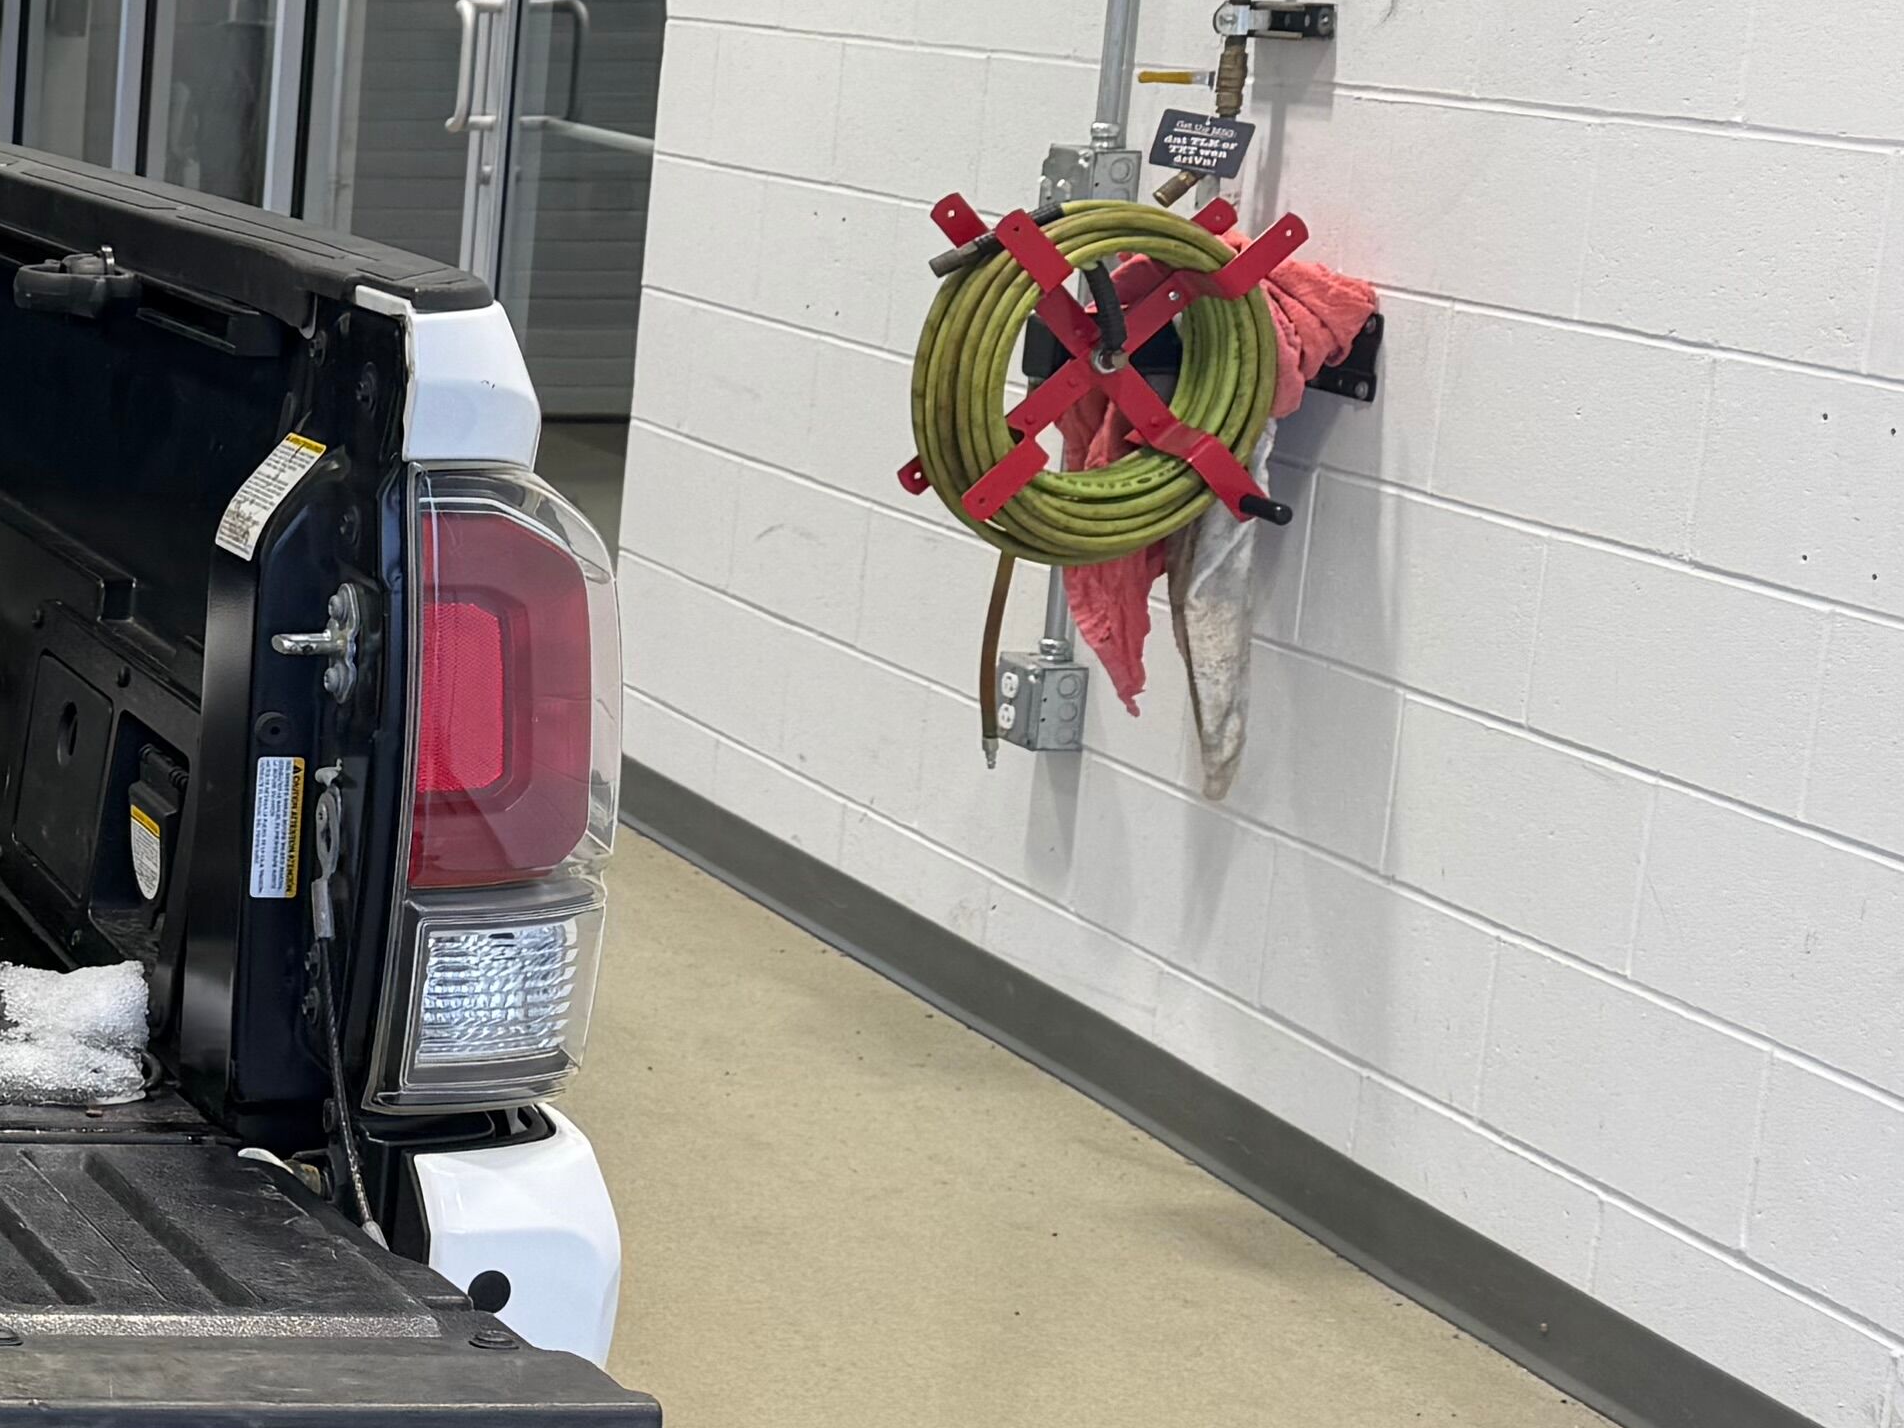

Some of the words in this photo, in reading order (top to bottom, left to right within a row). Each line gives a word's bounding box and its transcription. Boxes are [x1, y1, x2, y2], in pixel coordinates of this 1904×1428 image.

[1164, 134, 1187, 144] dnt
[1190, 136, 1220, 147] TLK
[1222, 142, 1238, 150] or
[1199, 149, 1227, 158] wen
